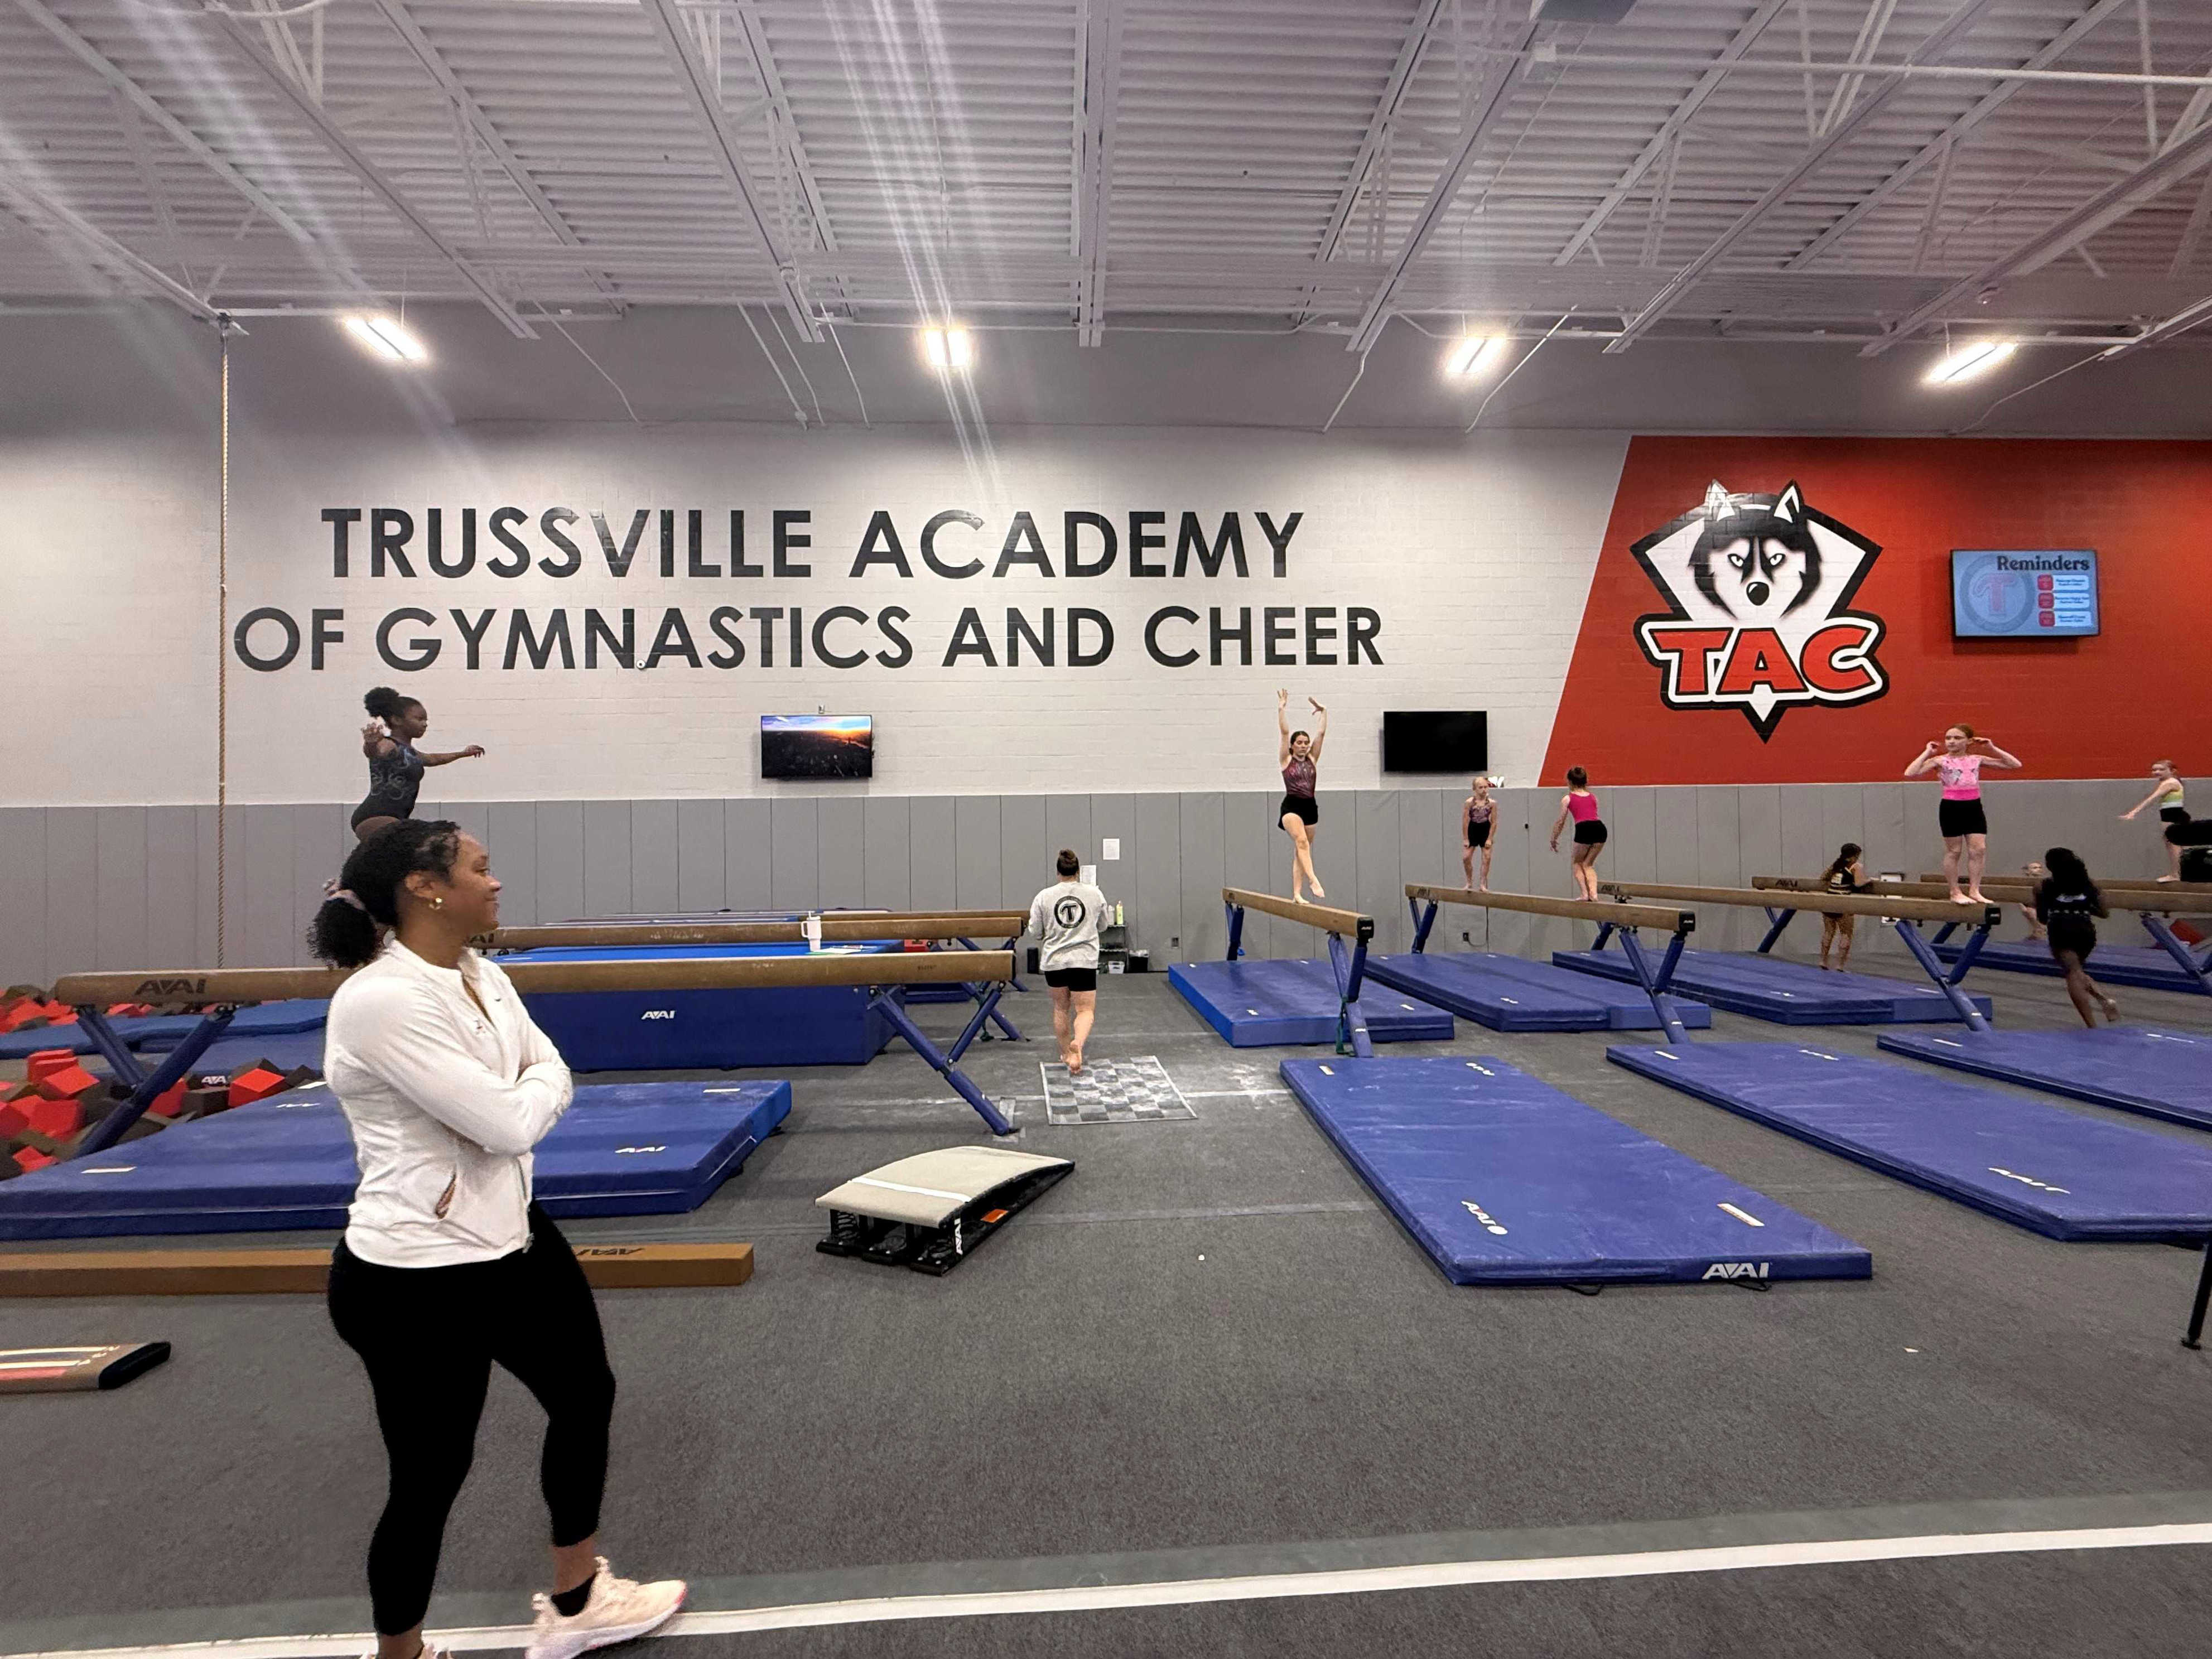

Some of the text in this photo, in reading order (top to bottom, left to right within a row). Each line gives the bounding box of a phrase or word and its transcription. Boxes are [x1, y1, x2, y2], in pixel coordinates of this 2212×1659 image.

[321, 507, 1304, 578] TRUSSVILLE ACADEMY
[1997, 554, 2090, 570] Reminders
[234, 605, 1384, 672] OF GYMNASTICS AND CHEER
[1647, 624, 1877, 696] TAC
